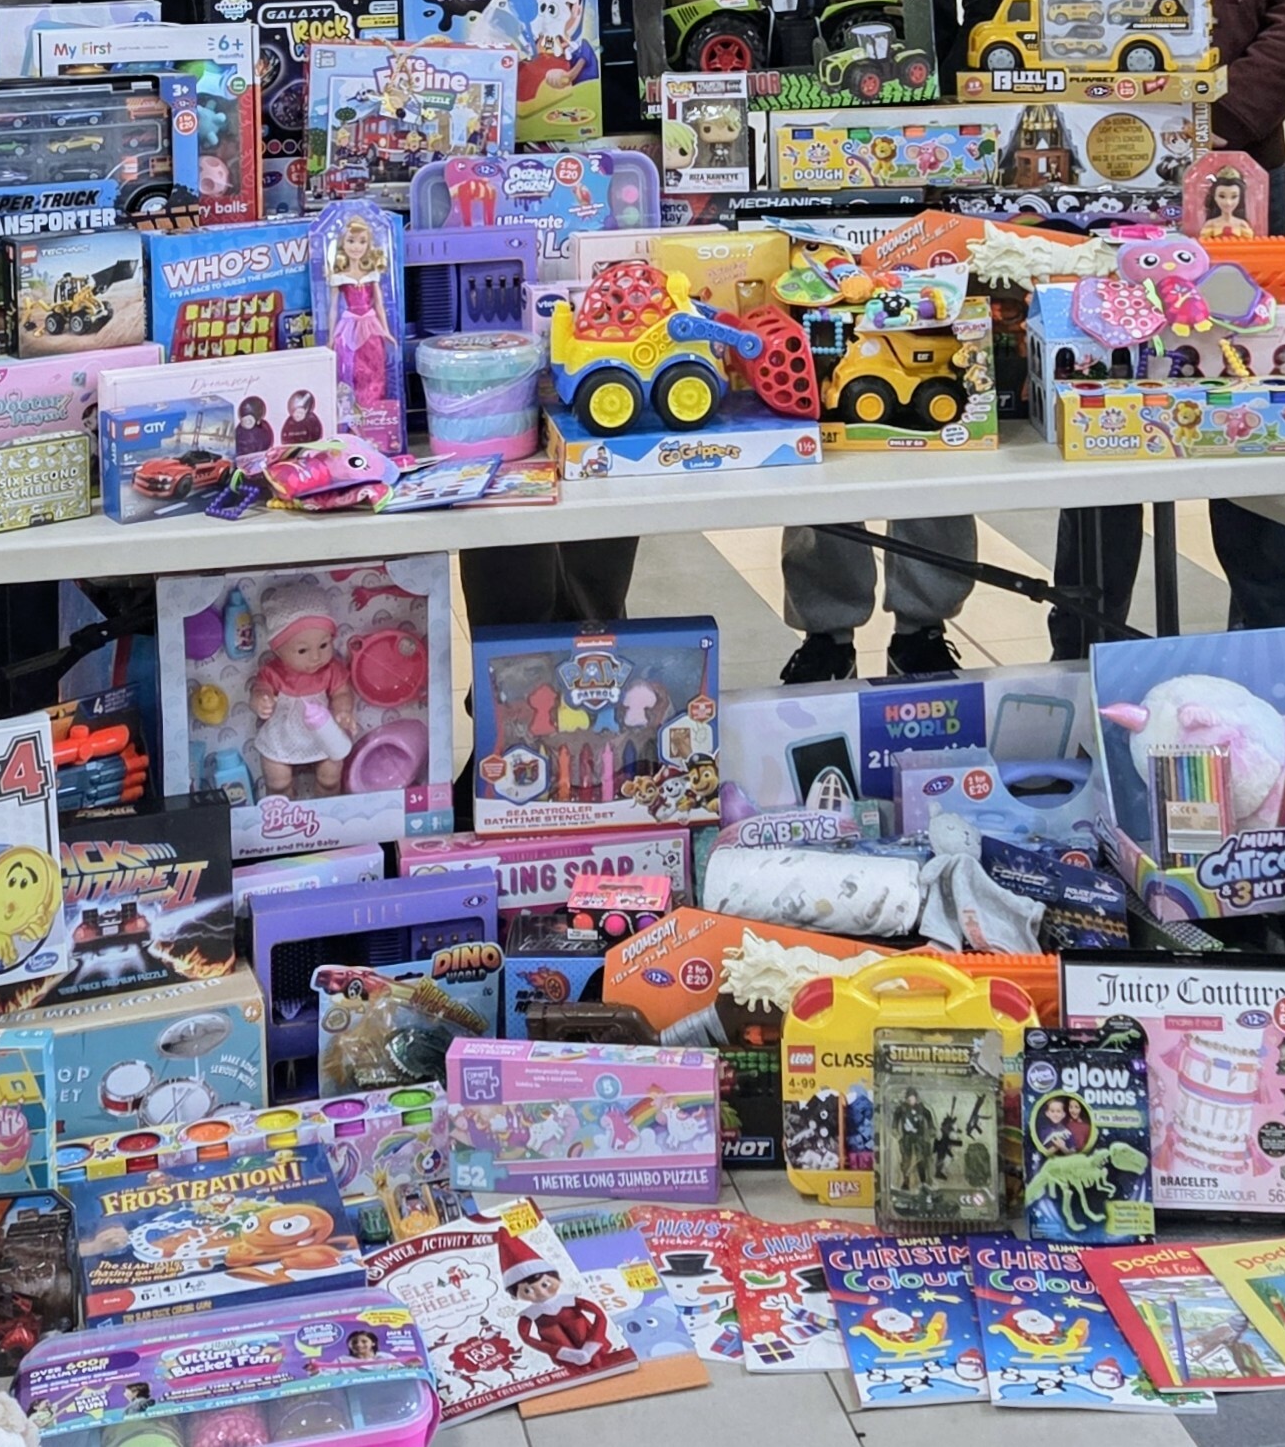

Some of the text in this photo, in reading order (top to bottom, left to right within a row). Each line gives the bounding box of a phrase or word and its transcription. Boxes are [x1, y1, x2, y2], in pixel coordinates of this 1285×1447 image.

[266, 7, 333, 21] GALAXY
[294, 16, 350, 41] ROCK
[53, 41, 112, 58] My First
[218, 35, 244, 52] 6+
[992, 70, 1065, 92] BUILD
[794, 169, 843, 181] DOUGH
[215, 201, 248, 215] balls
[729, 196, 833, 210] MECHANICS
[876, 220, 927, 260] DOOMSDAY
[164, 245, 271, 290] WHO'S
[144, 421, 167, 434] CITY
[1084, 435, 1140, 450] DOUGH
[0, 467, 79, 488] SIX SECOND
[3, 480, 76, 500] SCRIBBLES
[561, 659, 634, 688] PAW
[575, 689, 617, 700] PATROL
[884, 698, 960, 720] HOBBY
[885, 716, 961, 739] WORLD
[0, 741, 45, 795] 4
[969, 784, 990, 796] £20
[264, 804, 318, 838] Baby
[484, 811, 615, 825] BATHTIME STENCIL SET
[506, 806, 593, 817] SEA PATROLLER
[739, 816, 837, 847] GABBY'S
[1235, 880, 1252, 905] 3
[354, 903, 403, 927] ELLE
[621, 916, 680, 966] DOOMSDAY
[432, 943, 501, 975] DINO
[445, 968, 490, 984] WORLD
[685, 972, 710, 986] £20
[1097, 973, 1170, 1009] Juicy
[789, 1053, 814, 1066] LEGO
[889, 1046, 970, 1063] STEALTH FORCES
[788, 1078, 816, 1089] 4-99
[1062, 1064, 1130, 1095] glow
[1083, 1089, 1137, 1105] DINOS
[455, 1165, 489, 1188] 52
[541, 1168, 710, 1191] METRE LONG JUMBO PUZZLE
[1160, 1175, 1219, 1189] BRACELETS
[100, 1162, 301, 1216] FRUSTRATION!
[1160, 1187, 1198, 1202] LETTRES
[1201, 1188, 1257, 1202] D'AMOUR
[418, 1233, 494, 1255] ACTIVITY BOOK
[897, 1236, 942, 1247] BUMPER
[1112, 1249, 1191, 1273] Doodle
[178, 1344, 263, 1367] Ultimate
[464, 1345, 497, 1365] 150
[170, 1359, 234, 1379] Bucket
